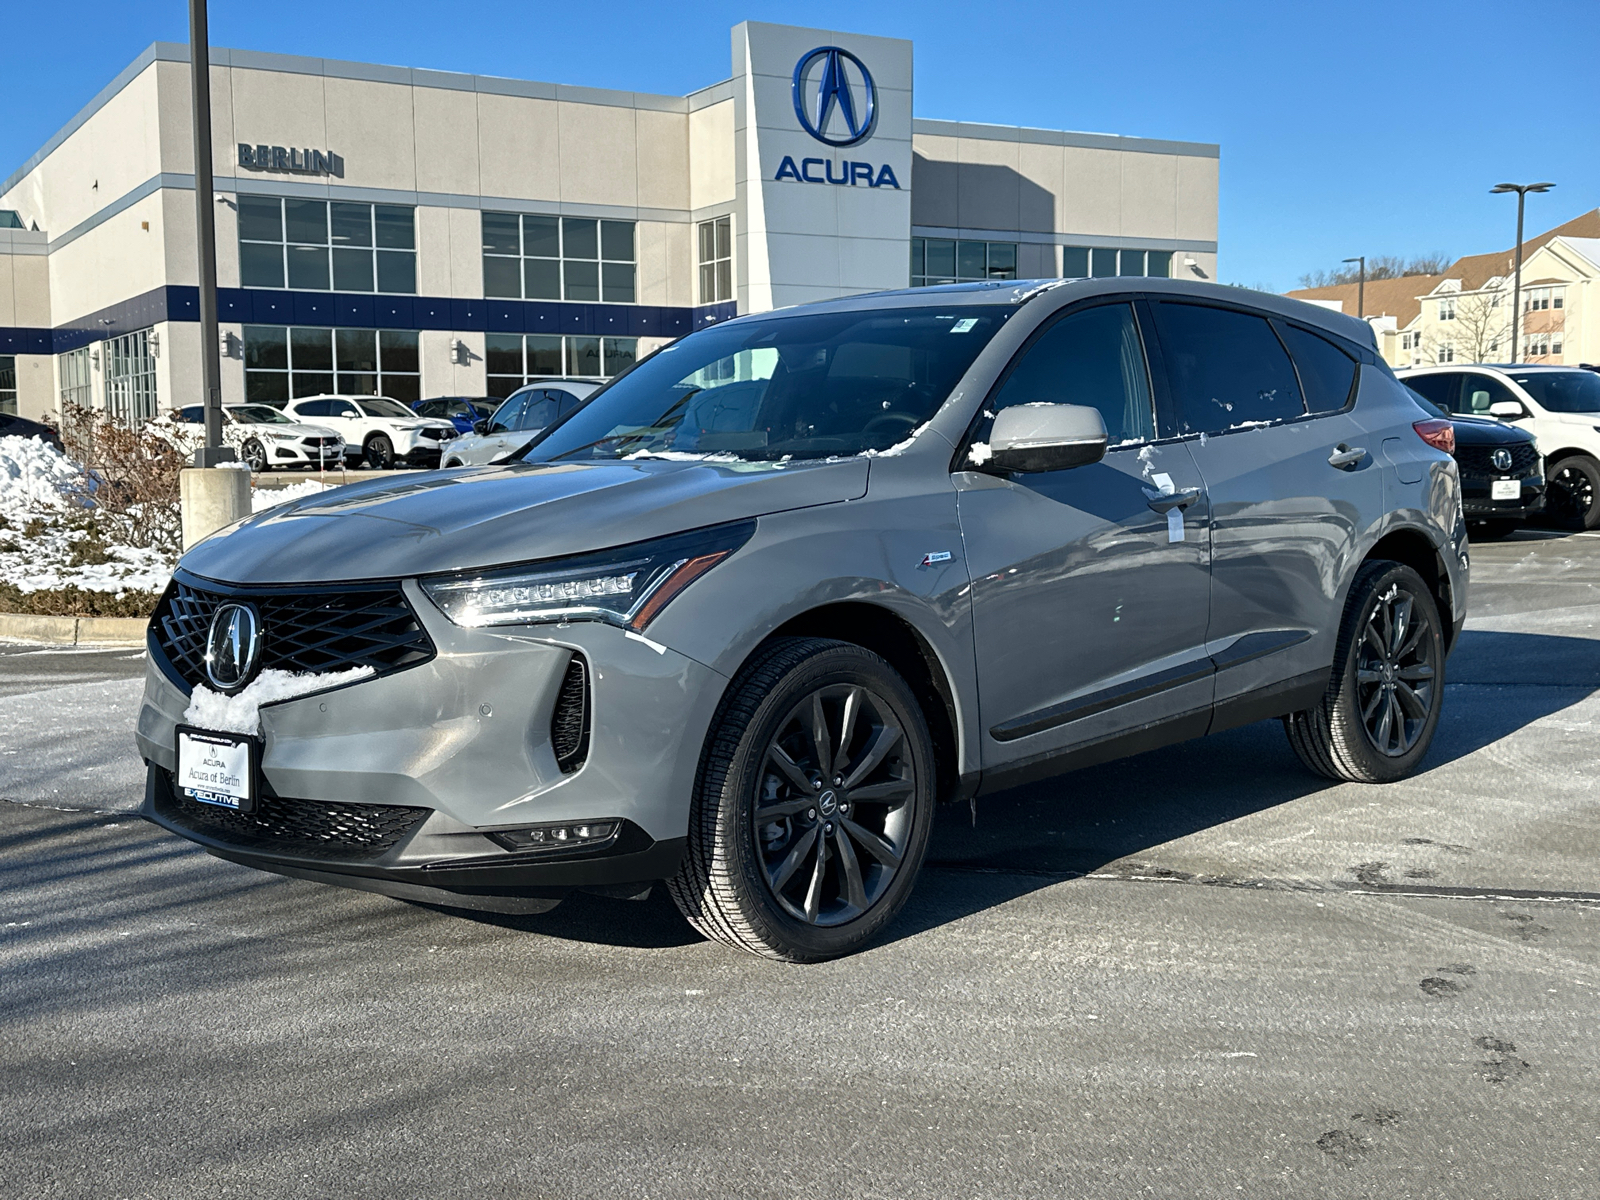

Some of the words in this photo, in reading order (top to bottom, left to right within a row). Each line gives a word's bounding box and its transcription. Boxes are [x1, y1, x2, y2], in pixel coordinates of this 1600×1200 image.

[238, 143, 334, 173] BERLIN
[775, 155, 901, 189] ACURA
[203, 758, 226, 769] ACURA
[188, 767, 208, 781] Acura
[210, 772, 219, 783] of
[219, 772, 240, 787] Berlin
[184, 787, 240, 806] EXECUTIVE
